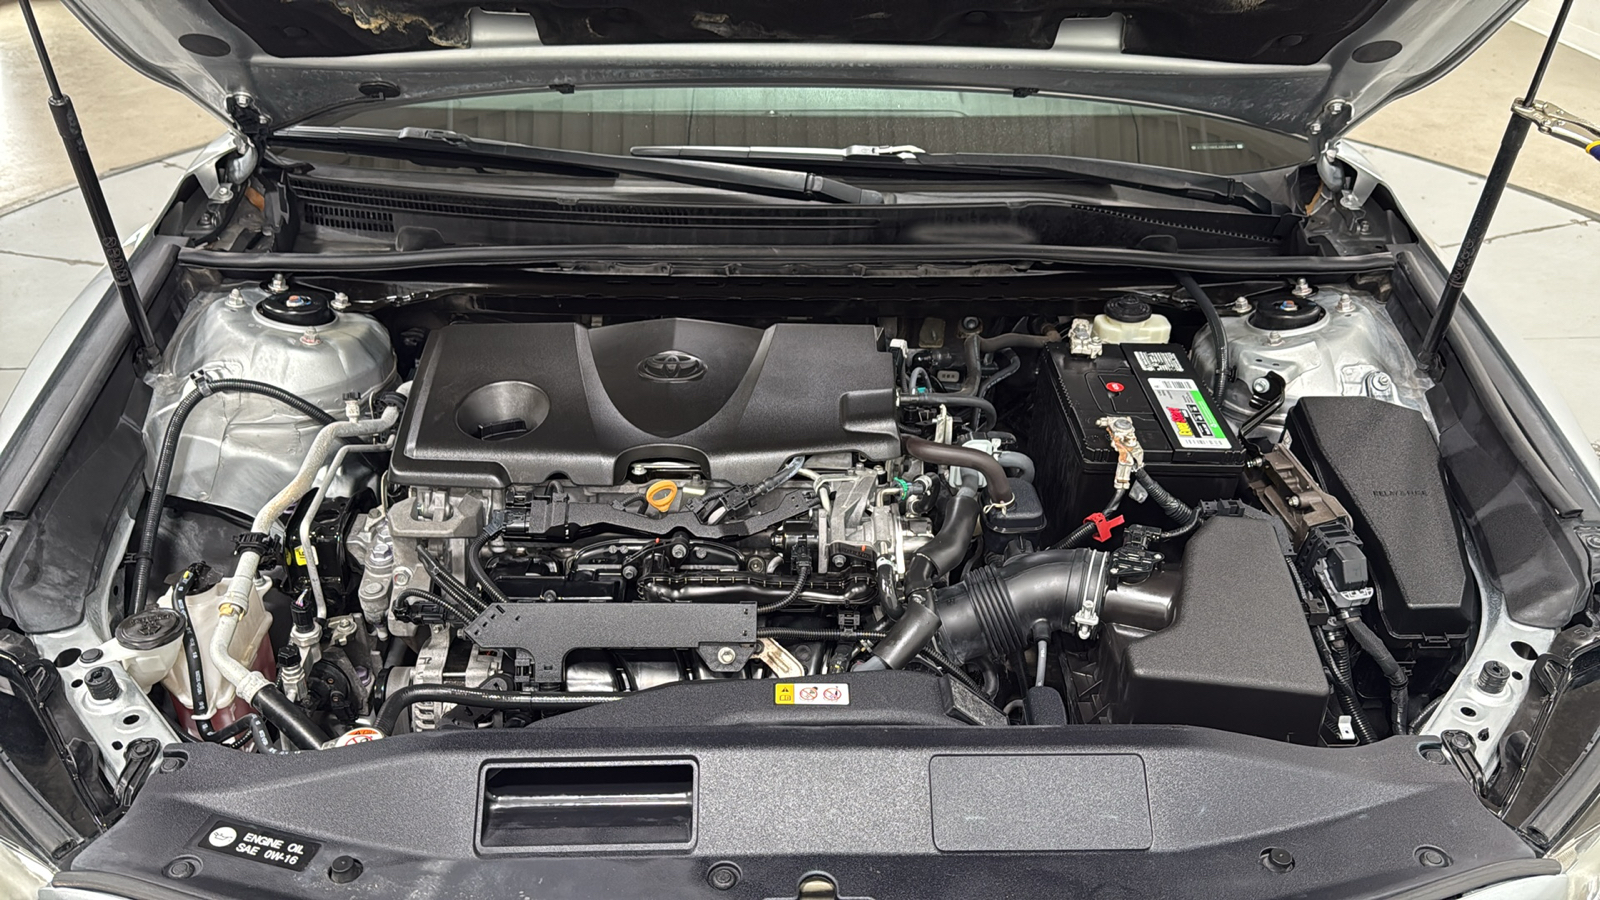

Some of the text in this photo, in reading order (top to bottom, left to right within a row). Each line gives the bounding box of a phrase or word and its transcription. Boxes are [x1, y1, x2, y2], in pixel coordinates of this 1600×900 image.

[235, 843, 299, 865] SAE 0W-16
[243, 832, 304, 855] ENGINE OIL
